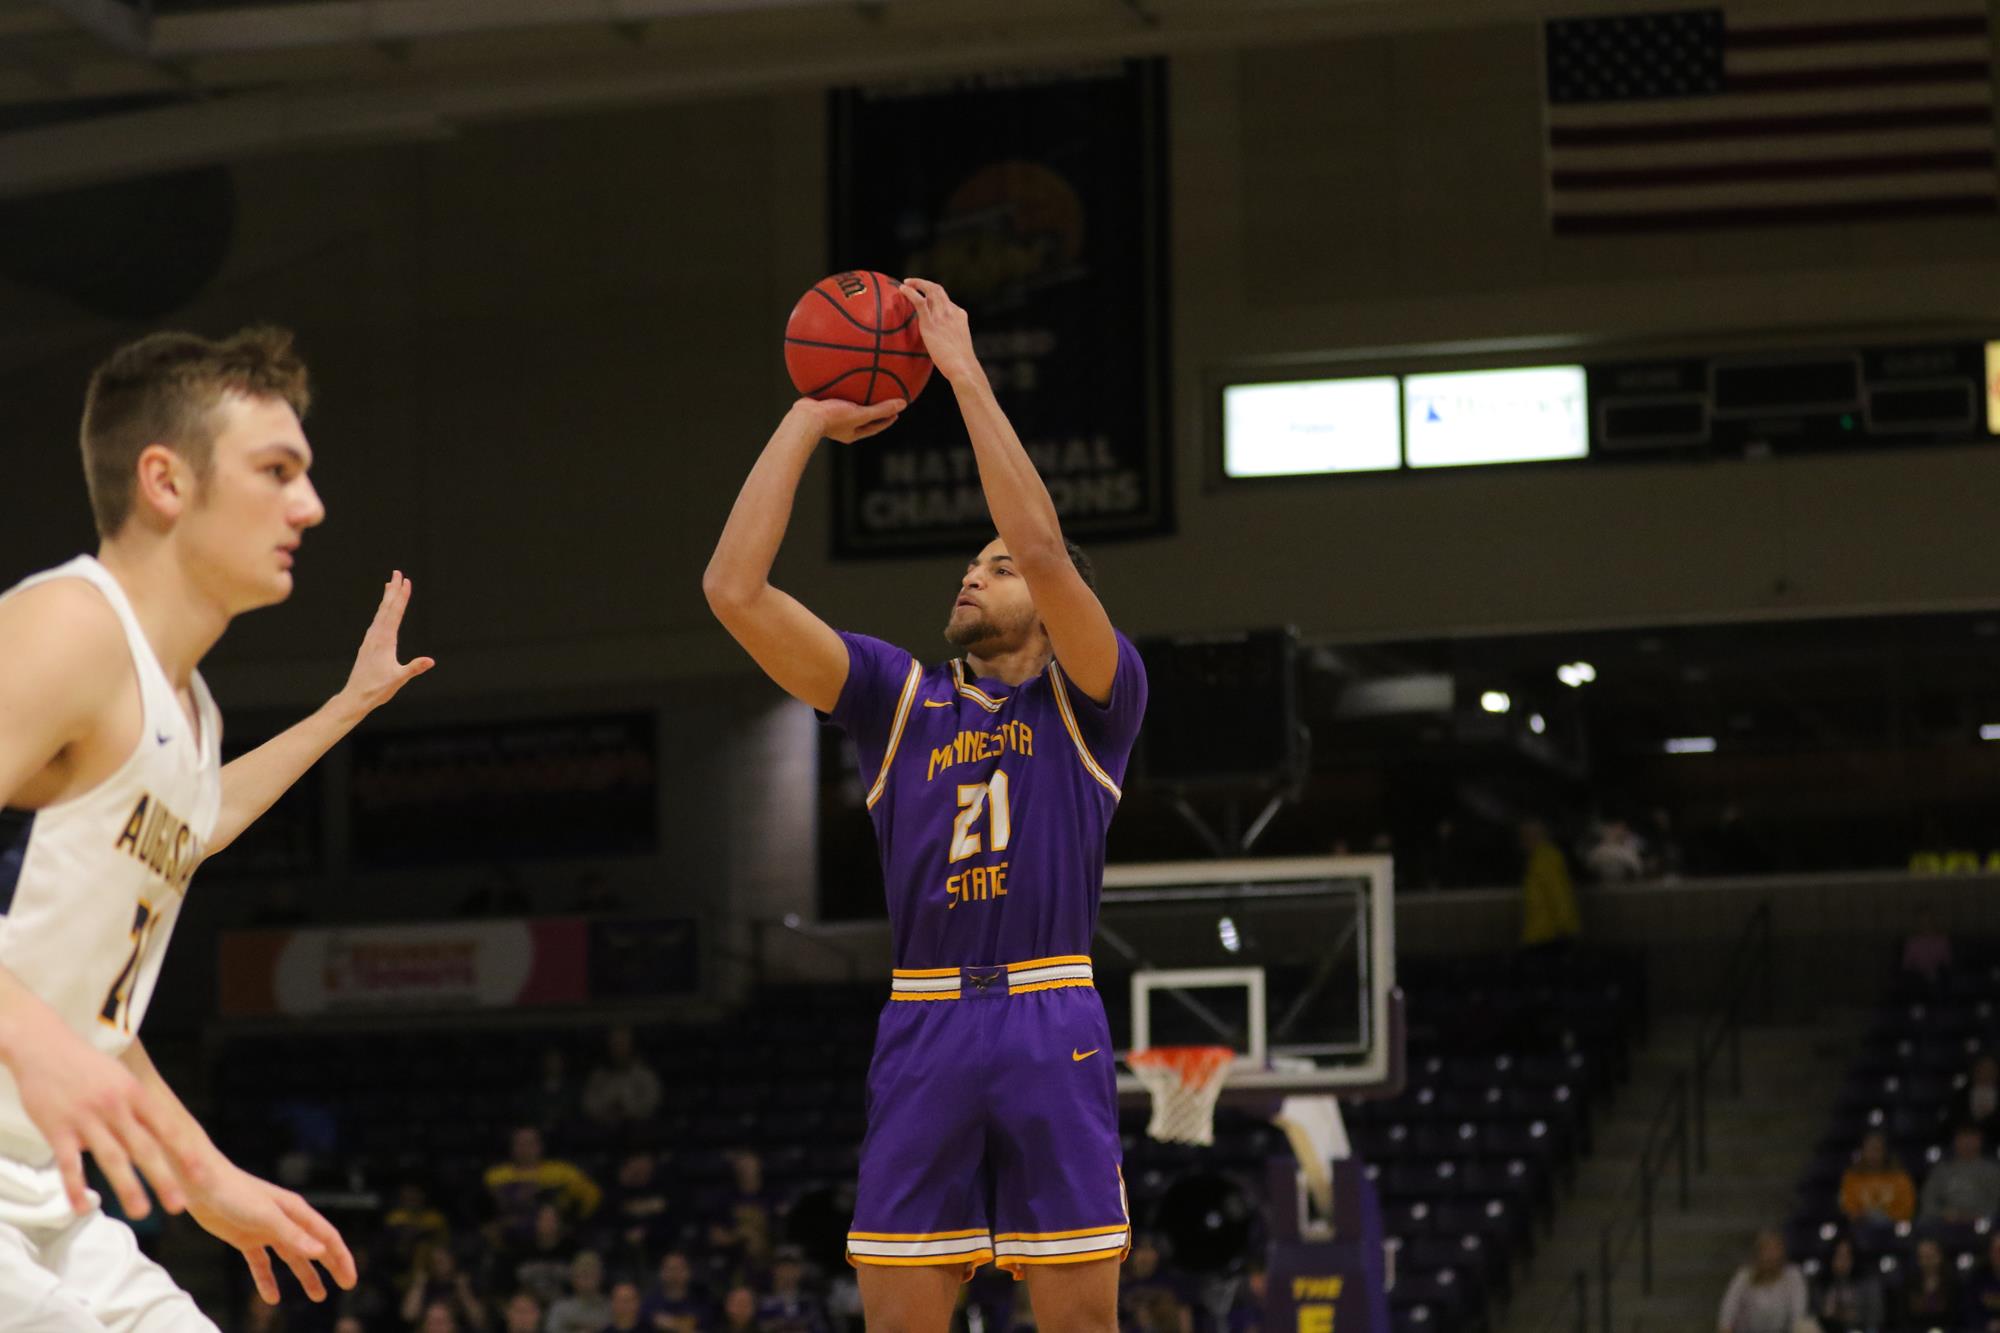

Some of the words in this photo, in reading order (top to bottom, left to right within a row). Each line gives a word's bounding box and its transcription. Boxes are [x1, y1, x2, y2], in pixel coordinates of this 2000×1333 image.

[882, 436, 1118, 483] NATNAL
[862, 471, 1141, 529] CHAMONS
[949, 769, 1012, 864] 21
[946, 862, 1009, 909] STATE
